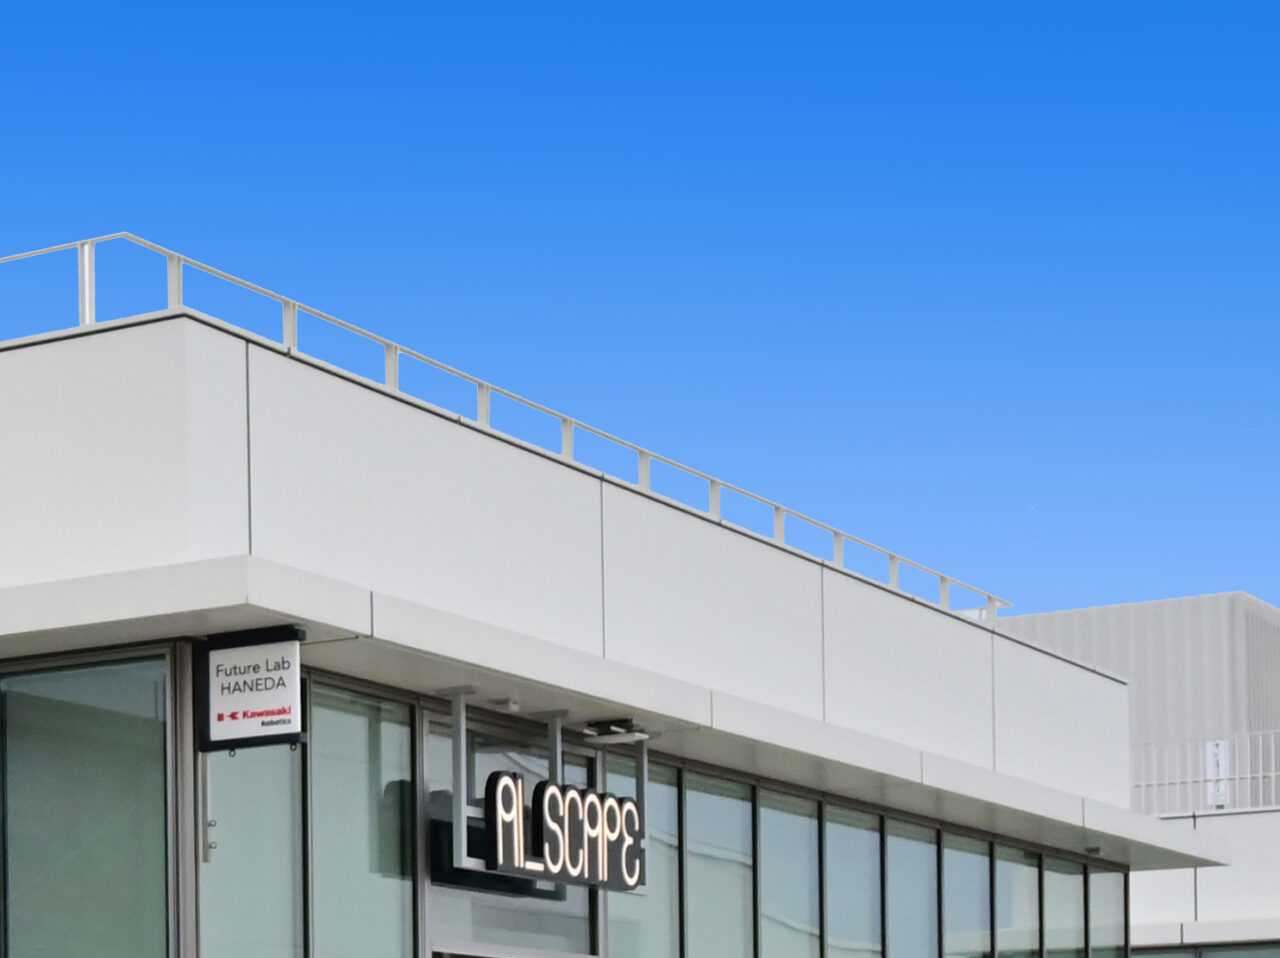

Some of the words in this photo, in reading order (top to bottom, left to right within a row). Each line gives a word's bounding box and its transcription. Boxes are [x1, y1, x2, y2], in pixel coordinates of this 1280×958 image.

[215, 663, 261, 678] Future
[265, 656, 292, 673] Lab
[221, 676, 287, 695] HANEDA
